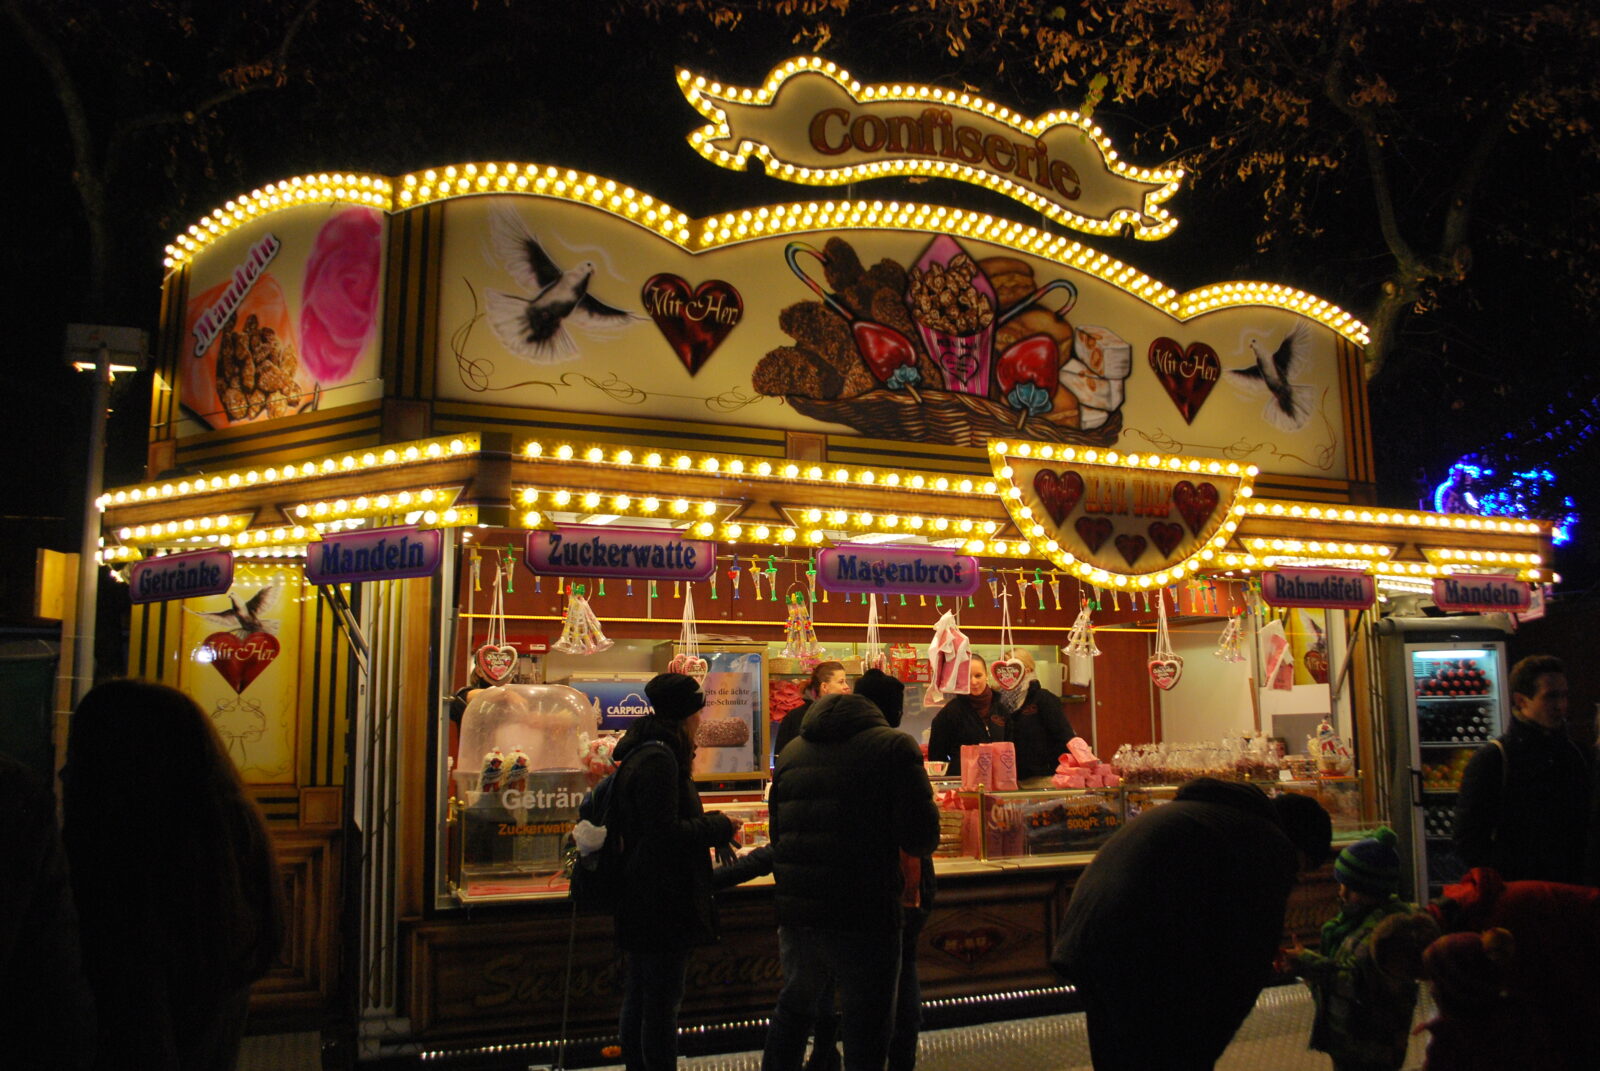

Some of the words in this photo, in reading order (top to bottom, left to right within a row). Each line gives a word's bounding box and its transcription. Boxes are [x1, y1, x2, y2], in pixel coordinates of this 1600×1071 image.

[808, 107, 1081, 200] Confiserie
[193, 234, 281, 356] Mandeln
[321, 535, 427, 574] Mandeln
[548, 533, 697, 569] Zuckerwatte
[138, 560, 222, 596] Getränke
[836, 554, 963, 585] Magenbrot
[1275, 574, 1364, 601] Rahmdäfeli
[1444, 578, 1520, 606] Mandeln
[502, 787, 591, 810] Geträn
